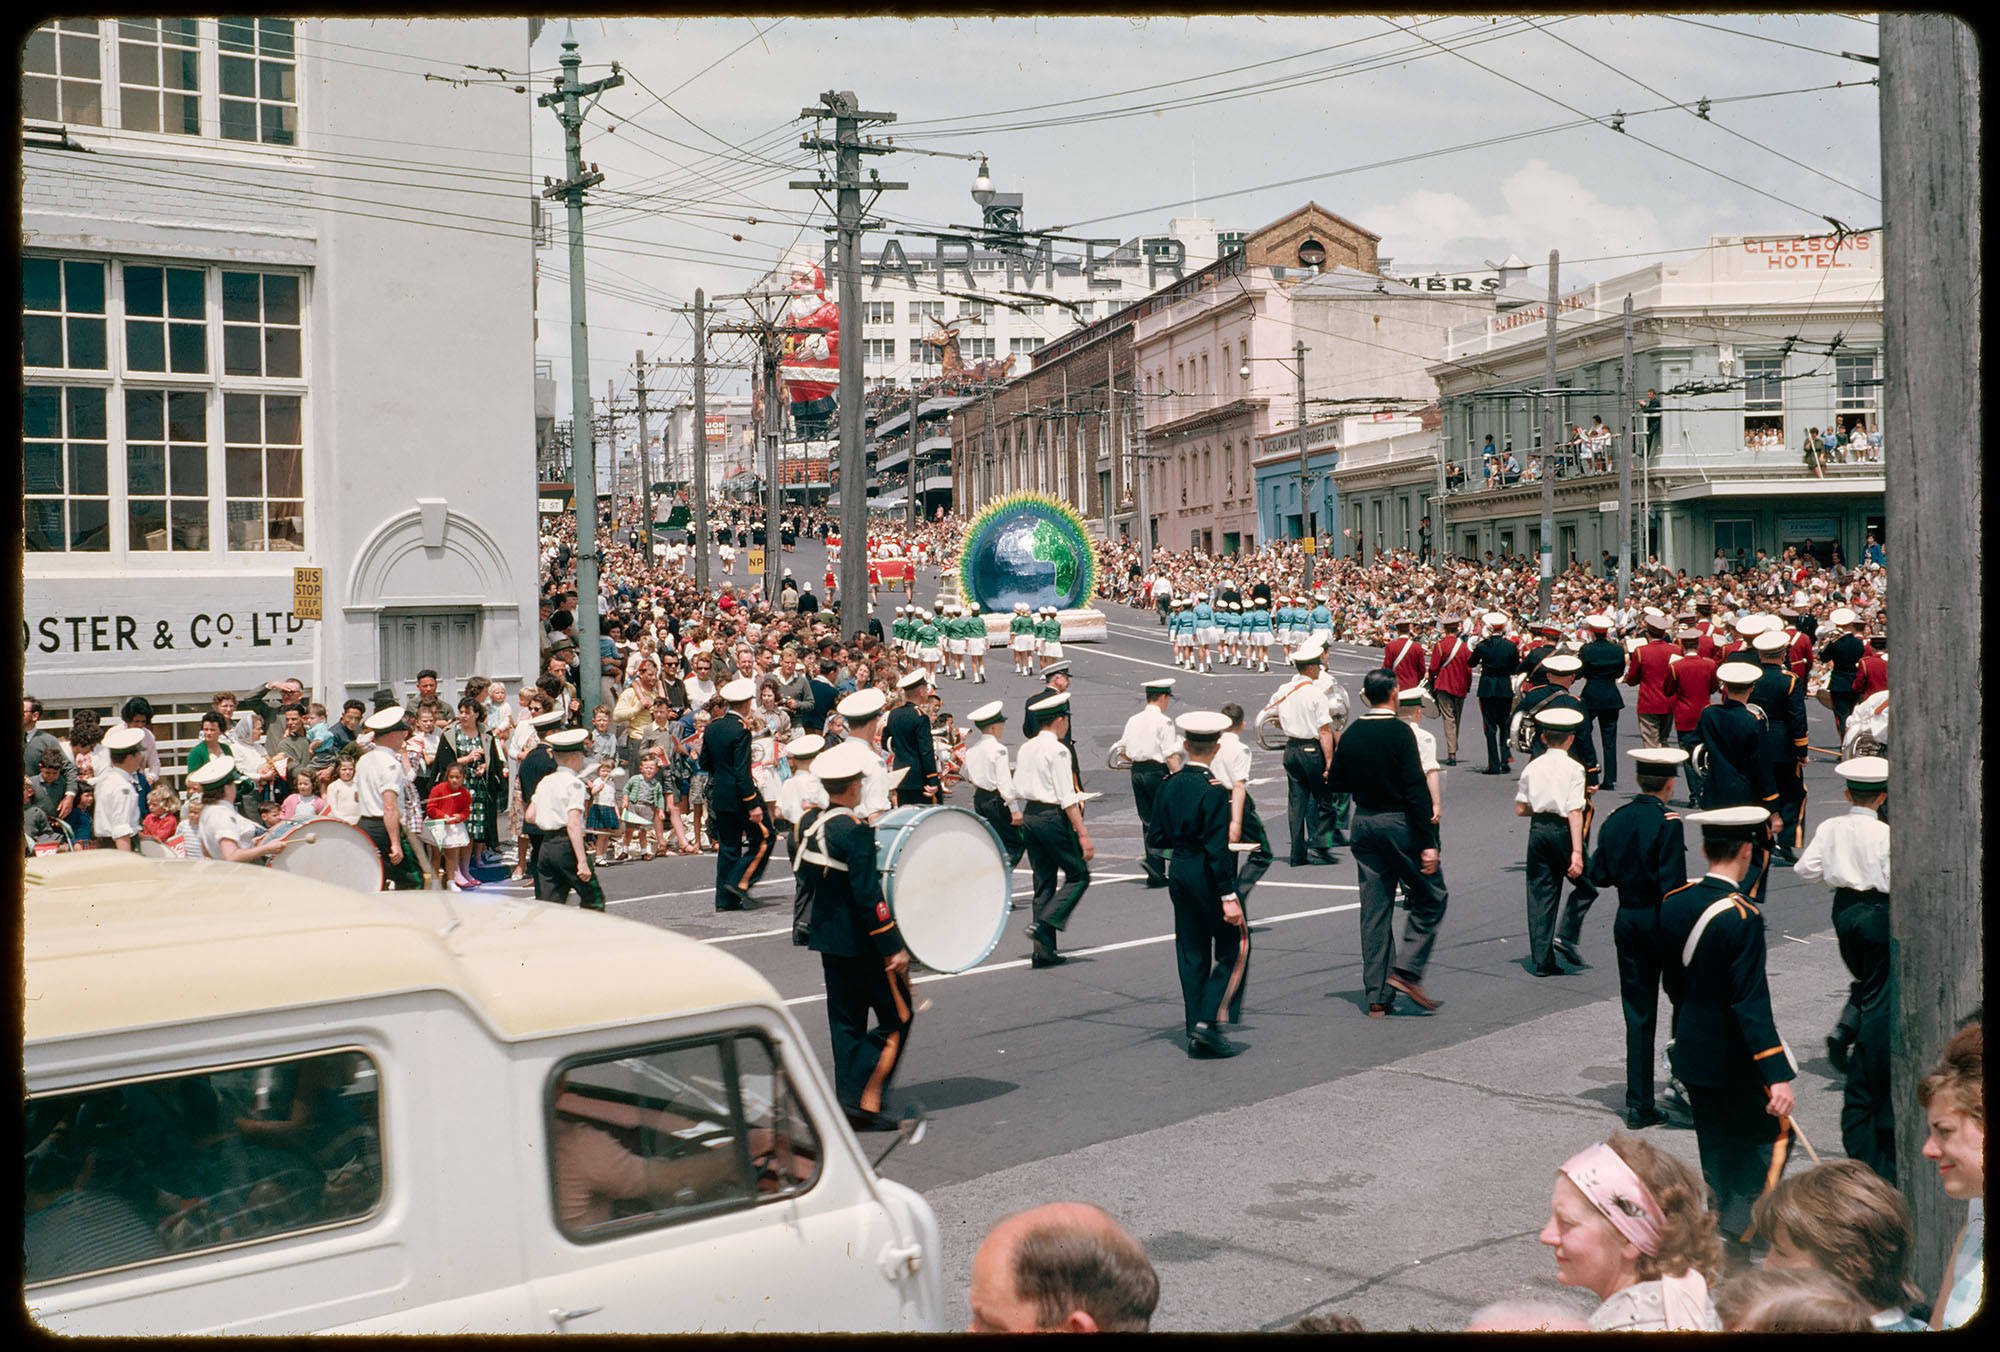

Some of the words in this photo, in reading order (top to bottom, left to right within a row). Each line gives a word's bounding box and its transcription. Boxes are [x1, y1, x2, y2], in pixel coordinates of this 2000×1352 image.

[749, 558, 763, 567] NP
[297, 570, 320, 582] BUS
[295, 584, 321, 595] STOP
[298, 600, 319, 608] KEEP
[153, 619, 174, 650] &
